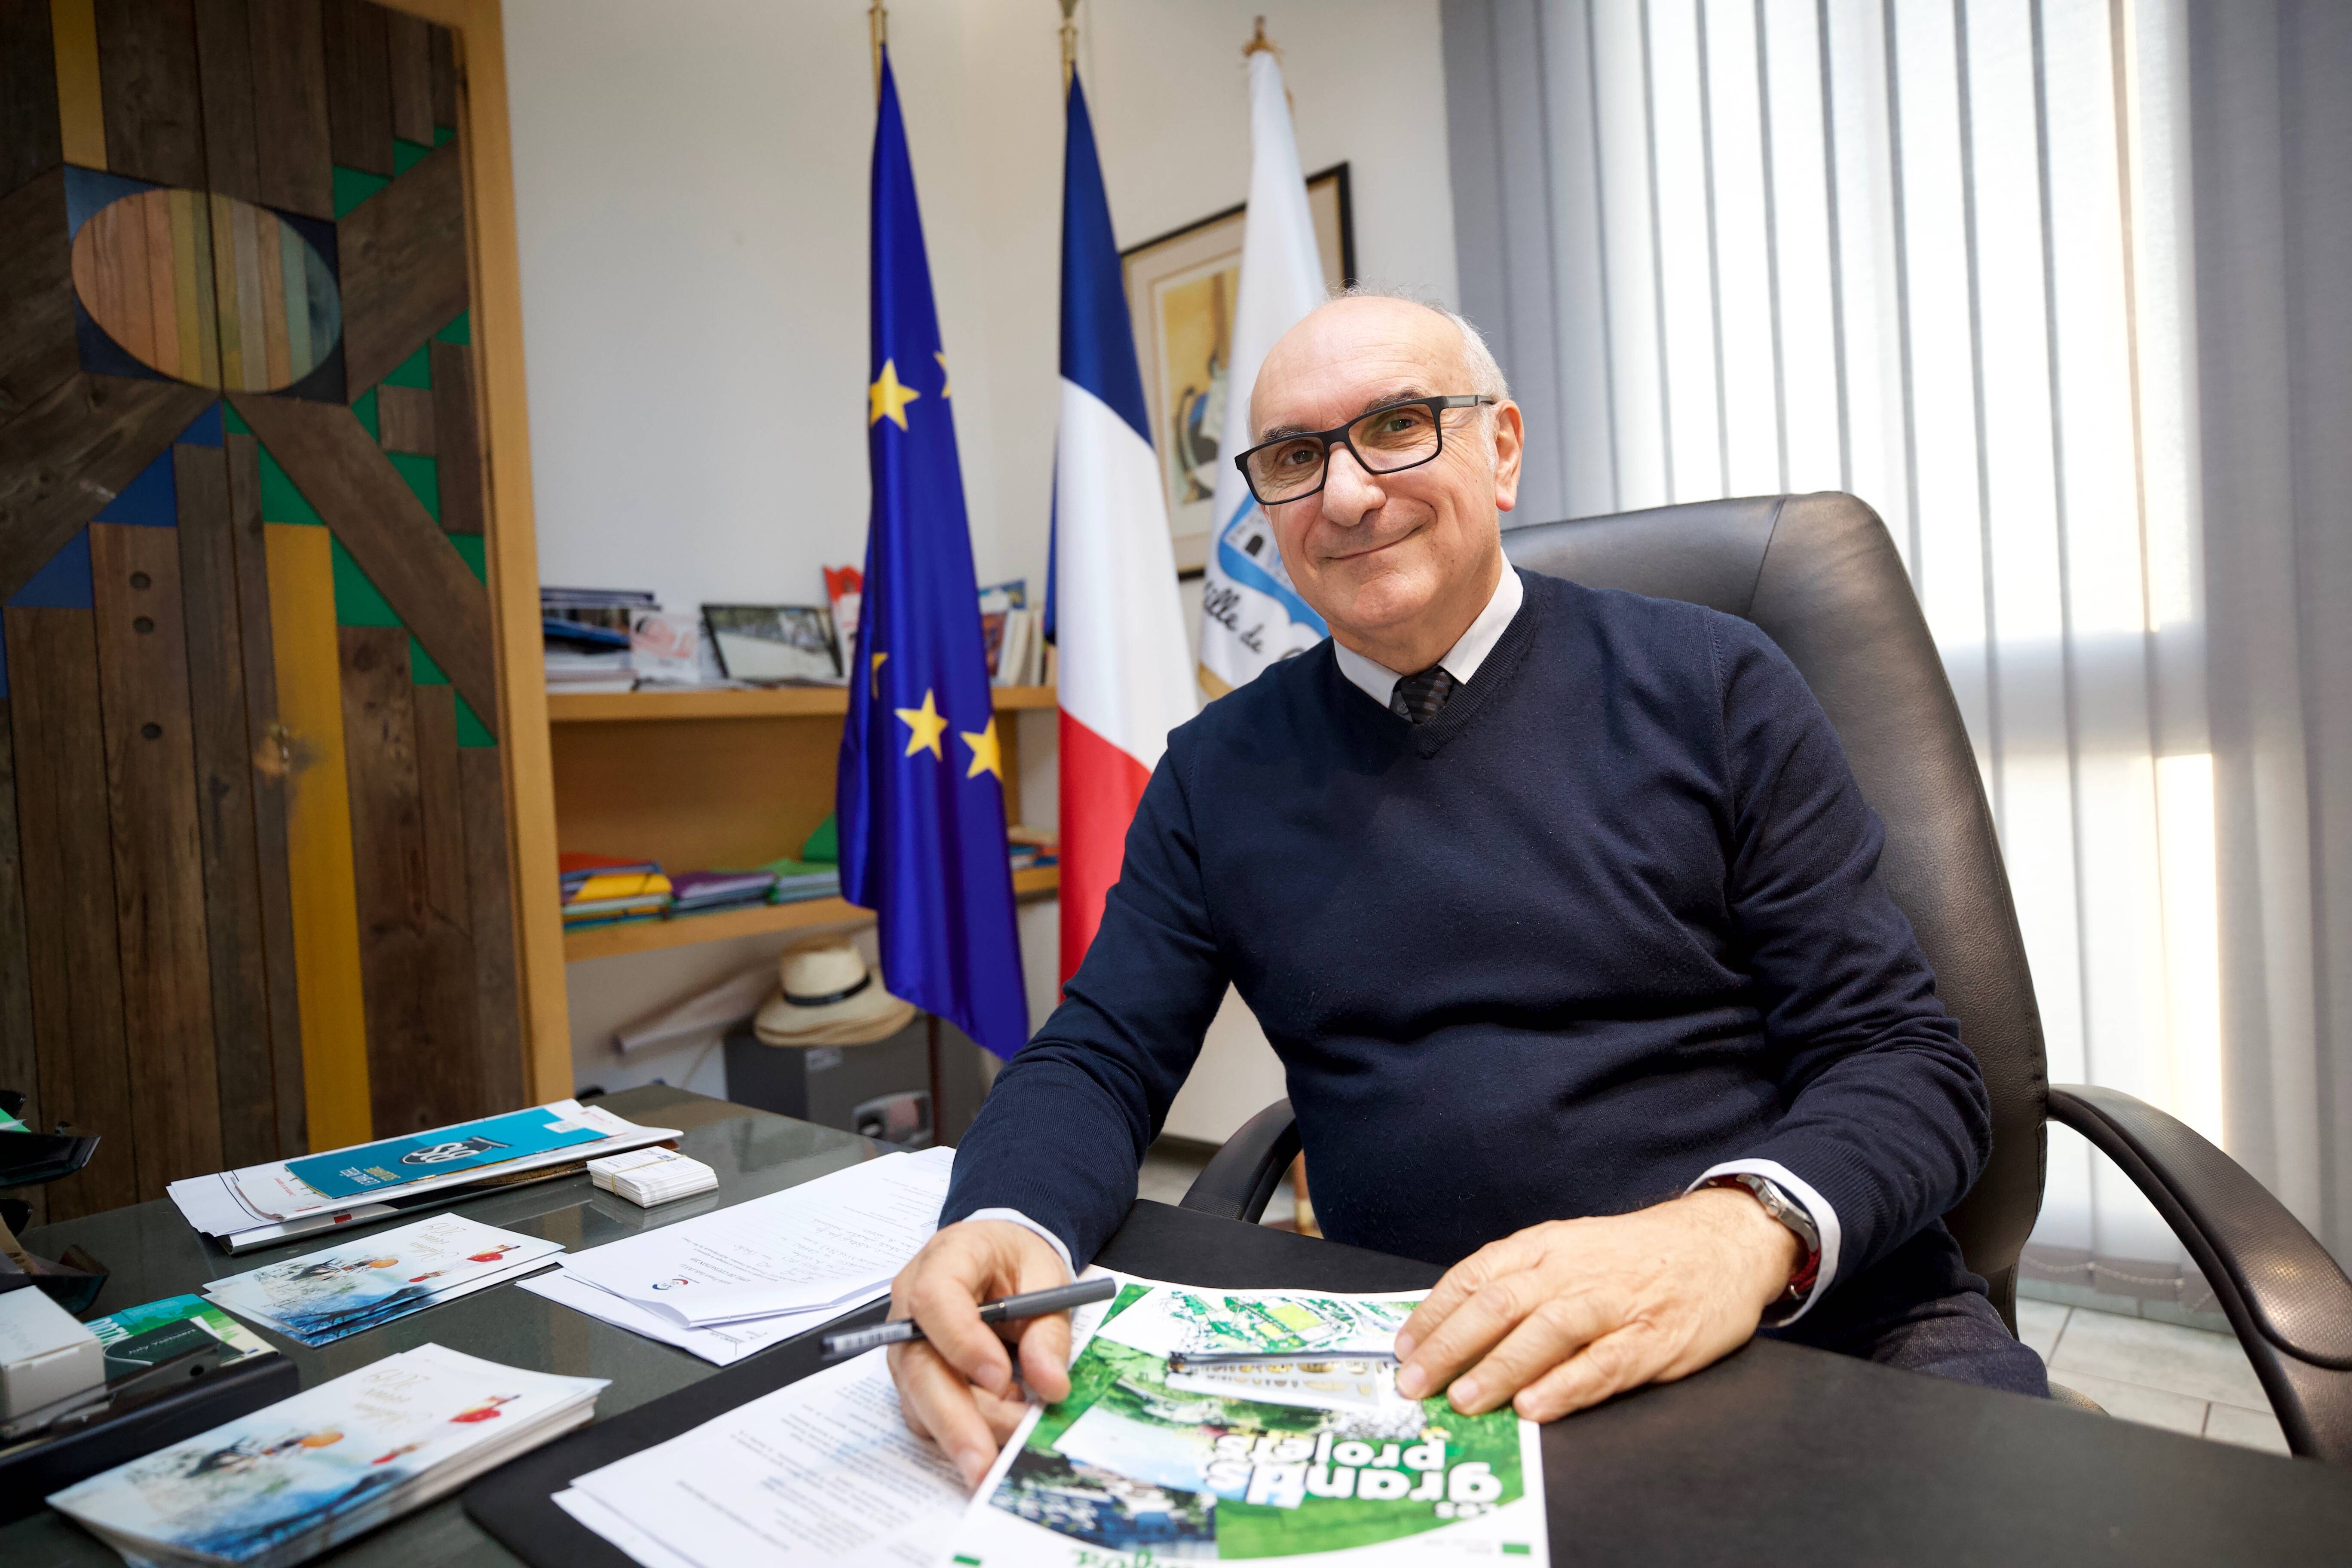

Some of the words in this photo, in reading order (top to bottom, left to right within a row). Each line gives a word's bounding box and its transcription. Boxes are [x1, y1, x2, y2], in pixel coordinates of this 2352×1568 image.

[700, 1262, 728, 1274] COTISATION
[1216, 1431, 1447, 1471] projets
[1204, 1461, 1503, 1509] grands
